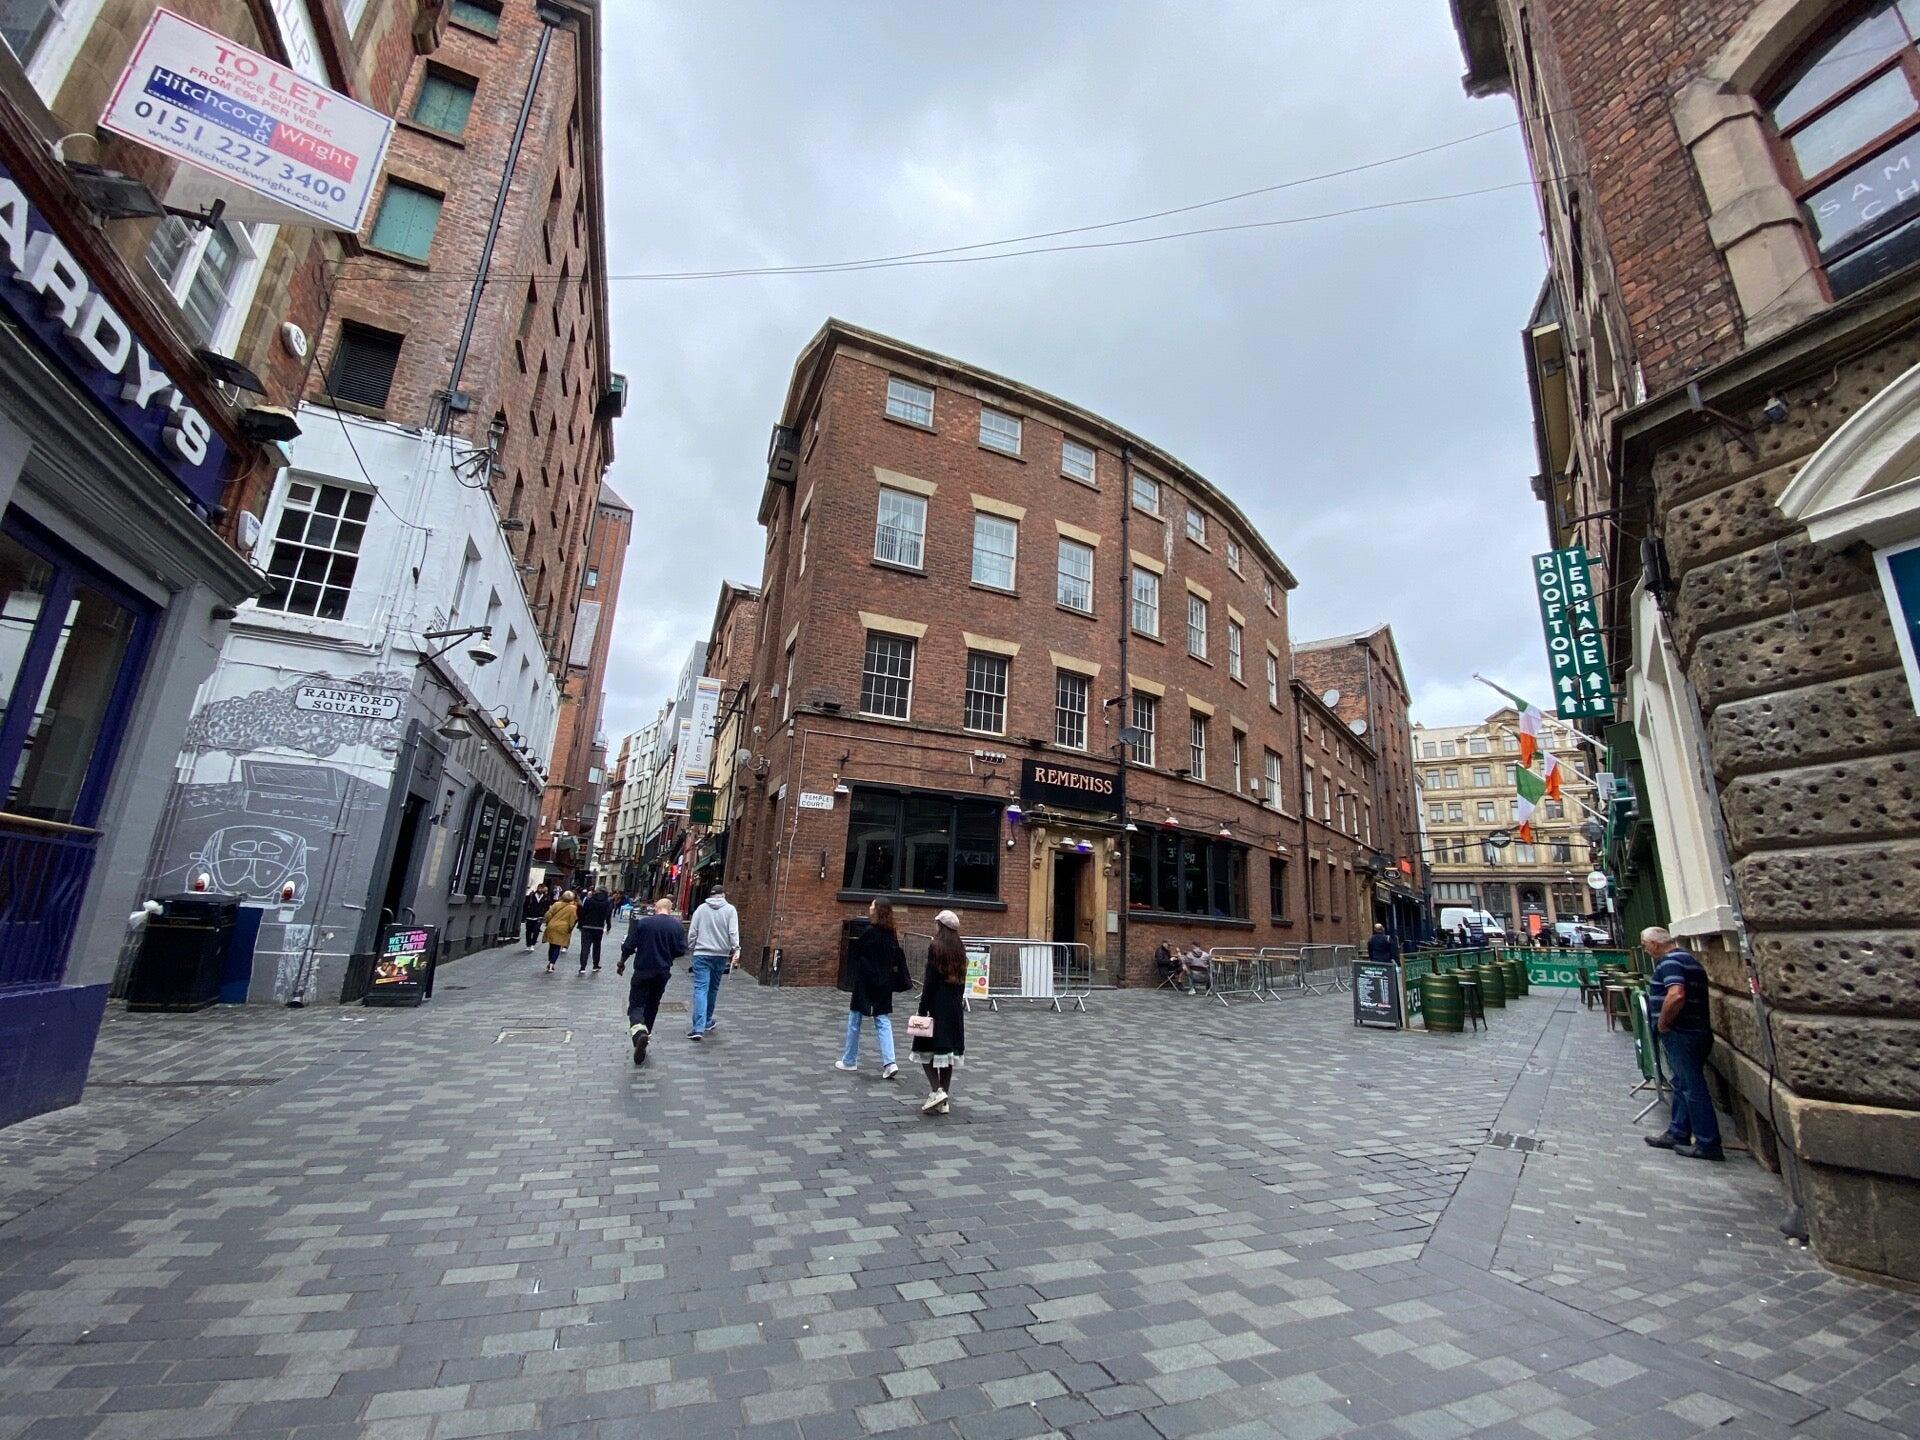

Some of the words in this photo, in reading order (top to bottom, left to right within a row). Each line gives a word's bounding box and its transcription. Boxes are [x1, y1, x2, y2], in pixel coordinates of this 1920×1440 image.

[189, 66, 231, 91] FROM
[261, 100, 290, 117] PER
[293, 114, 334, 138] WEEK
[215, 45, 259, 77] TO
[268, 72, 332, 110] LET
[215, 66, 266, 93] OFFICE
[268, 90, 318, 119] SUITES
[153, 68, 273, 133] Hitchcock
[280, 124, 353, 169] Wright
[253, 129, 269, 145] &
[135, 101, 203, 141] 0151
[216, 136, 270, 167] 227
[278, 163, 346, 202] 3400
[148, 128, 330, 210] www.hitchcockwright.co.uk
[1538, 556, 1570, 668] ROOFTOP
[1566, 550, 1599, 665] TERRACE
[304, 688, 394, 707] RAINFORD
[312, 700, 382, 716] SQUARE
[695, 703, 710, 762] BEATLES
[804, 794, 830, 803] TEMPLE
[1034, 766, 1113, 794] REMENISS
